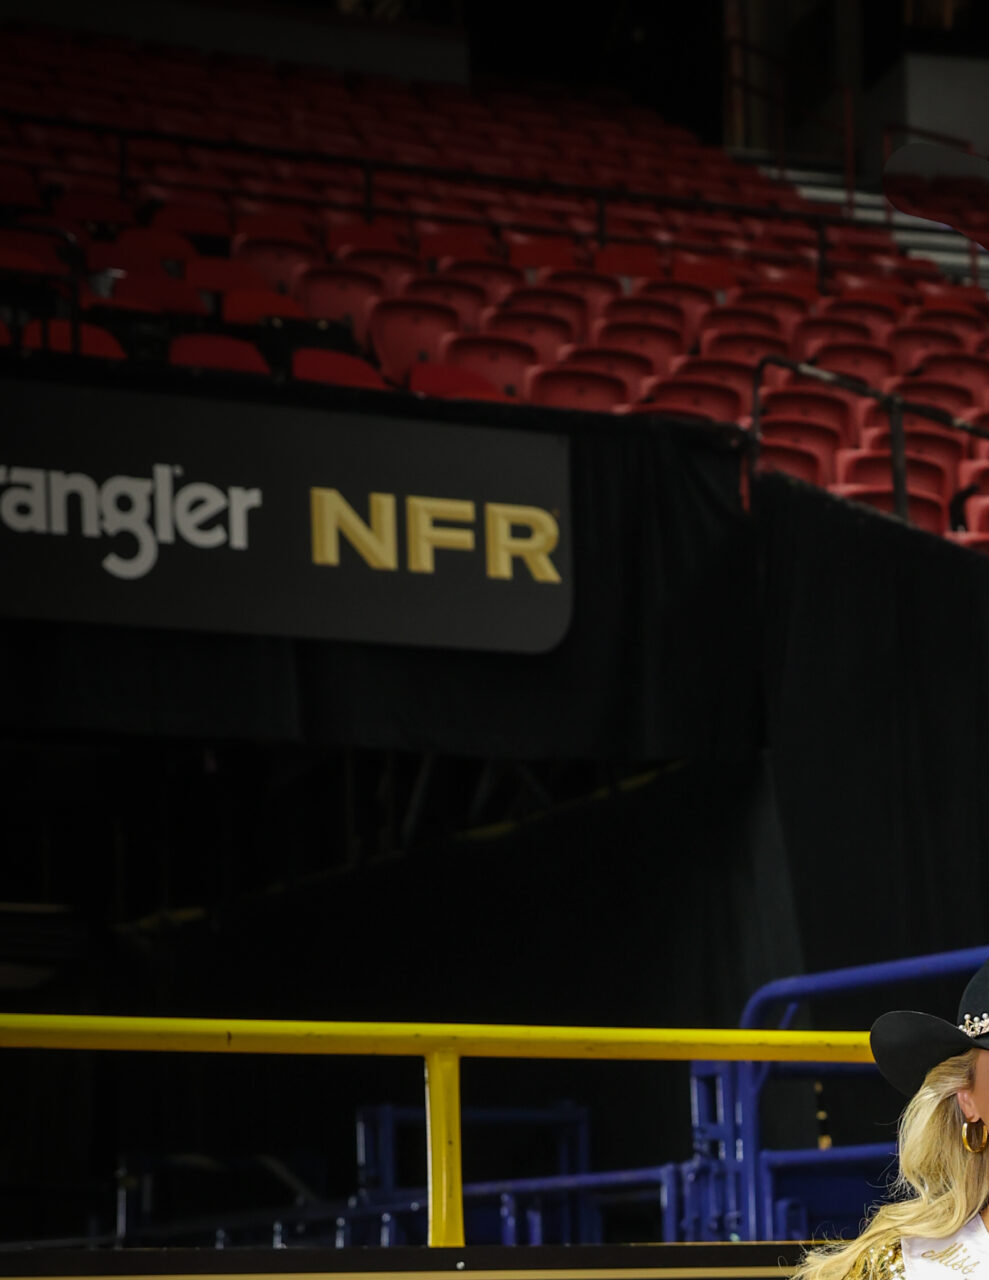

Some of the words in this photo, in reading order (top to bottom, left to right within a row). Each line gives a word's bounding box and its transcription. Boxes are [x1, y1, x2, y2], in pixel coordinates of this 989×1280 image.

[0, 463, 262, 581] angler
[309, 486, 562, 584] NFR
[921, 1242, 980, 1275] Miss
